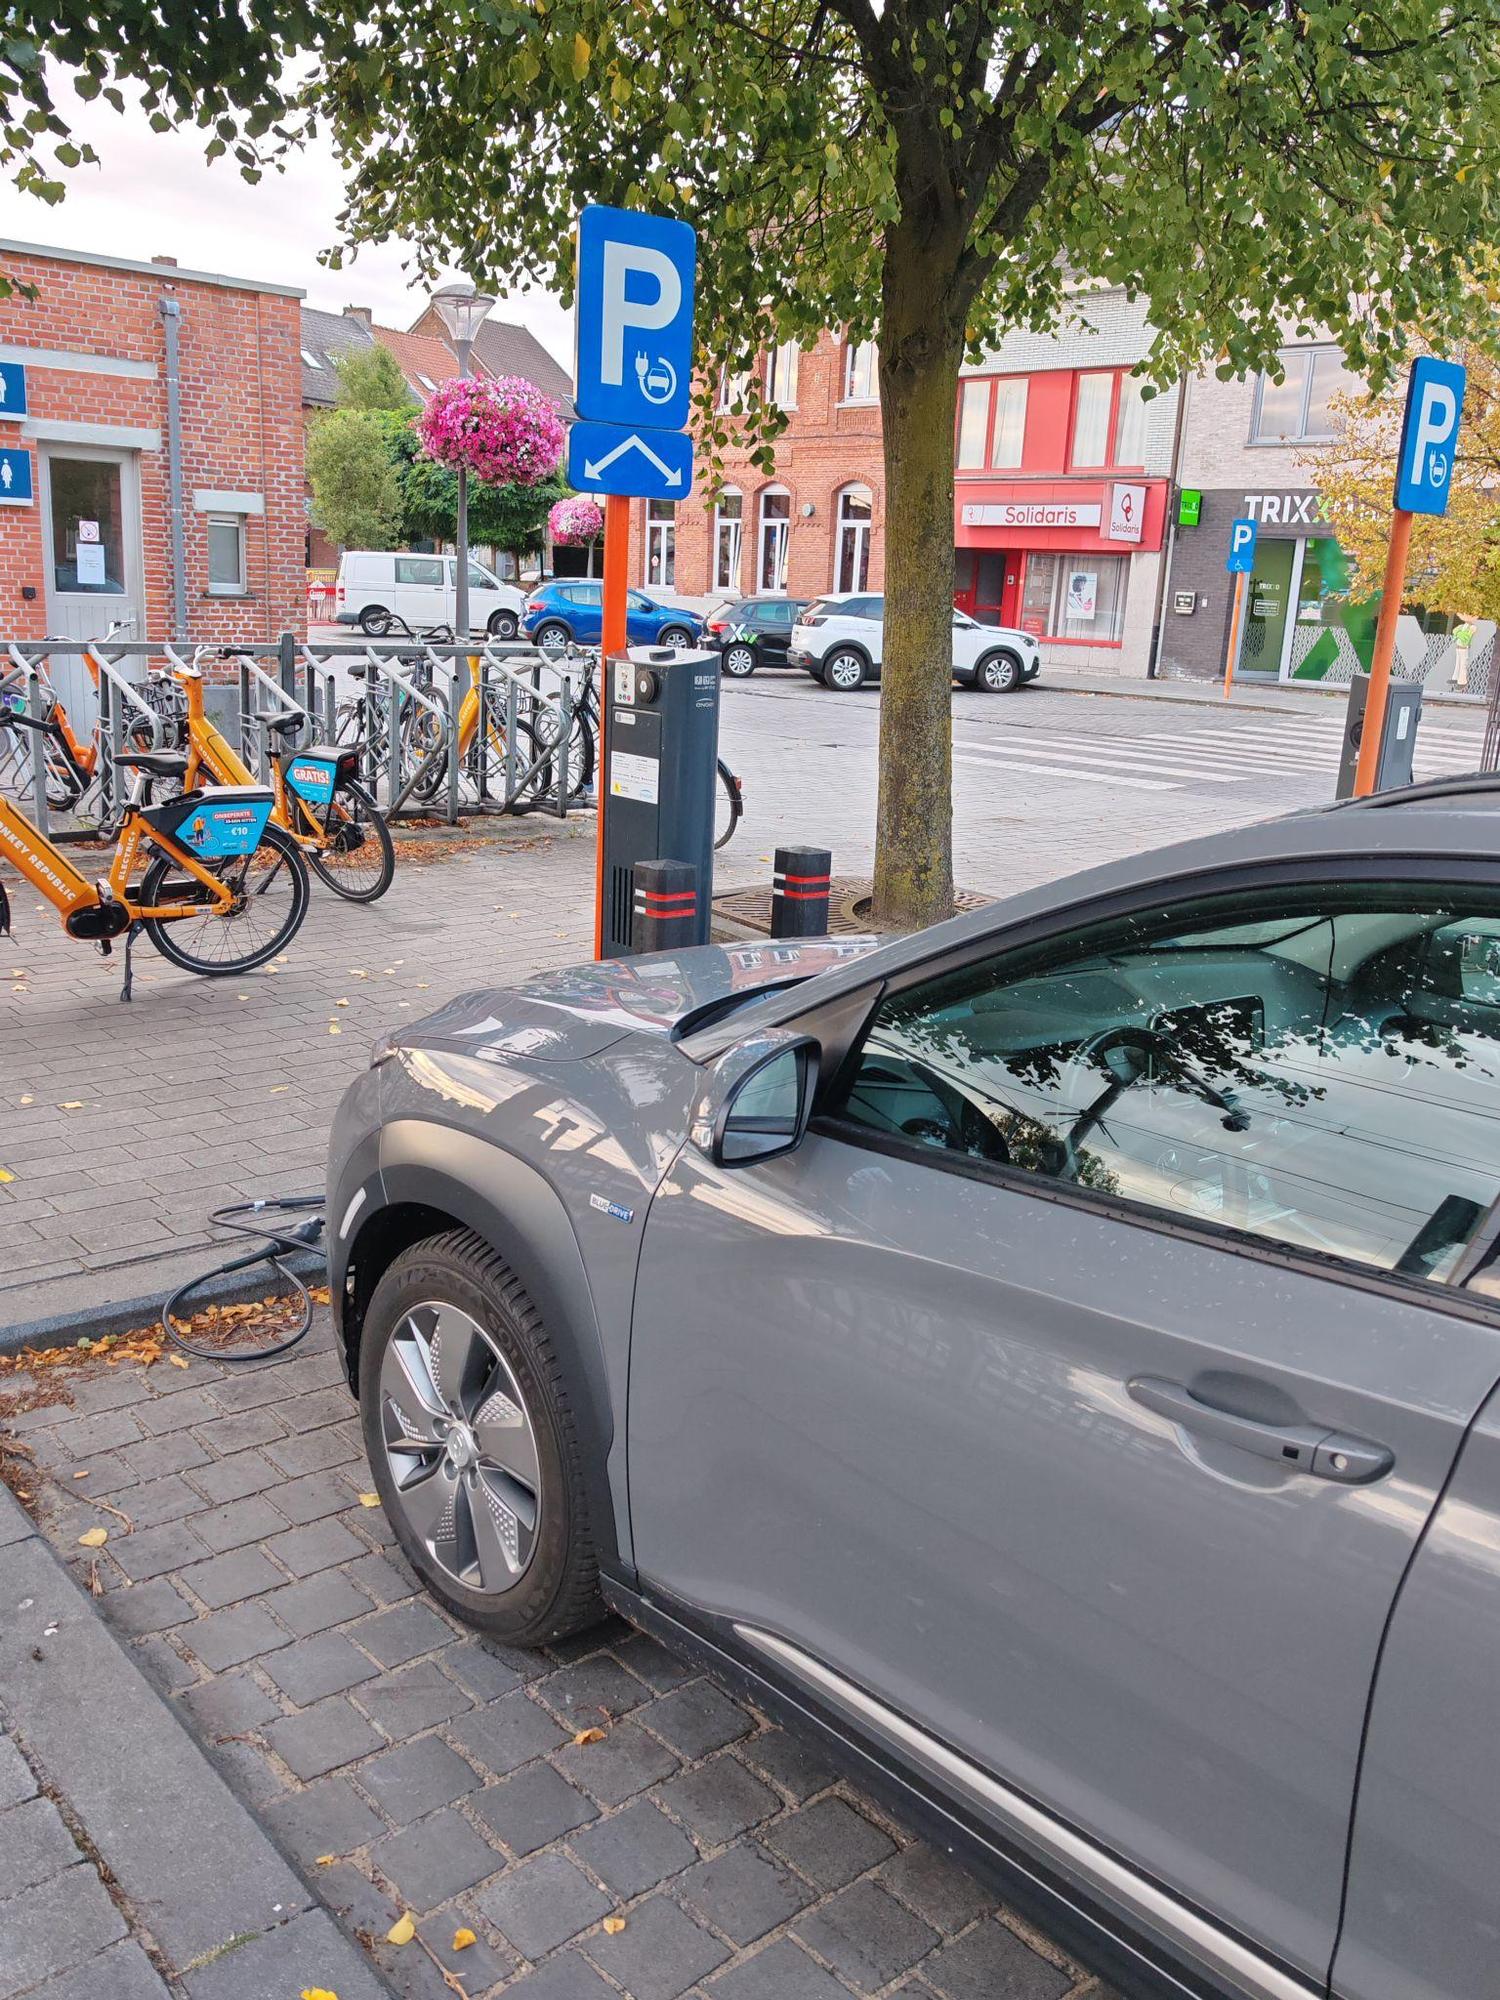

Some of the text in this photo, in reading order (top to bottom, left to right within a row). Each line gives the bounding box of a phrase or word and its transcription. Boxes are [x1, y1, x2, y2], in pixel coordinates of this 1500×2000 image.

[601, 240, 682, 386] P
[1411, 382, 1456, 485] P
[1005, 506, 1077, 524] Solidaris
[1244, 496, 1356, 523] TRIXX
[1111, 522, 1140, 535] Solidaris
[1233, 525, 1252, 552] P
[294, 768, 330, 785] GRATIS!
[231, 826, 248, 836] €10
[27, 854, 77, 901] REPUBLIC
[609, 1203, 630, 1221] DRIVE
